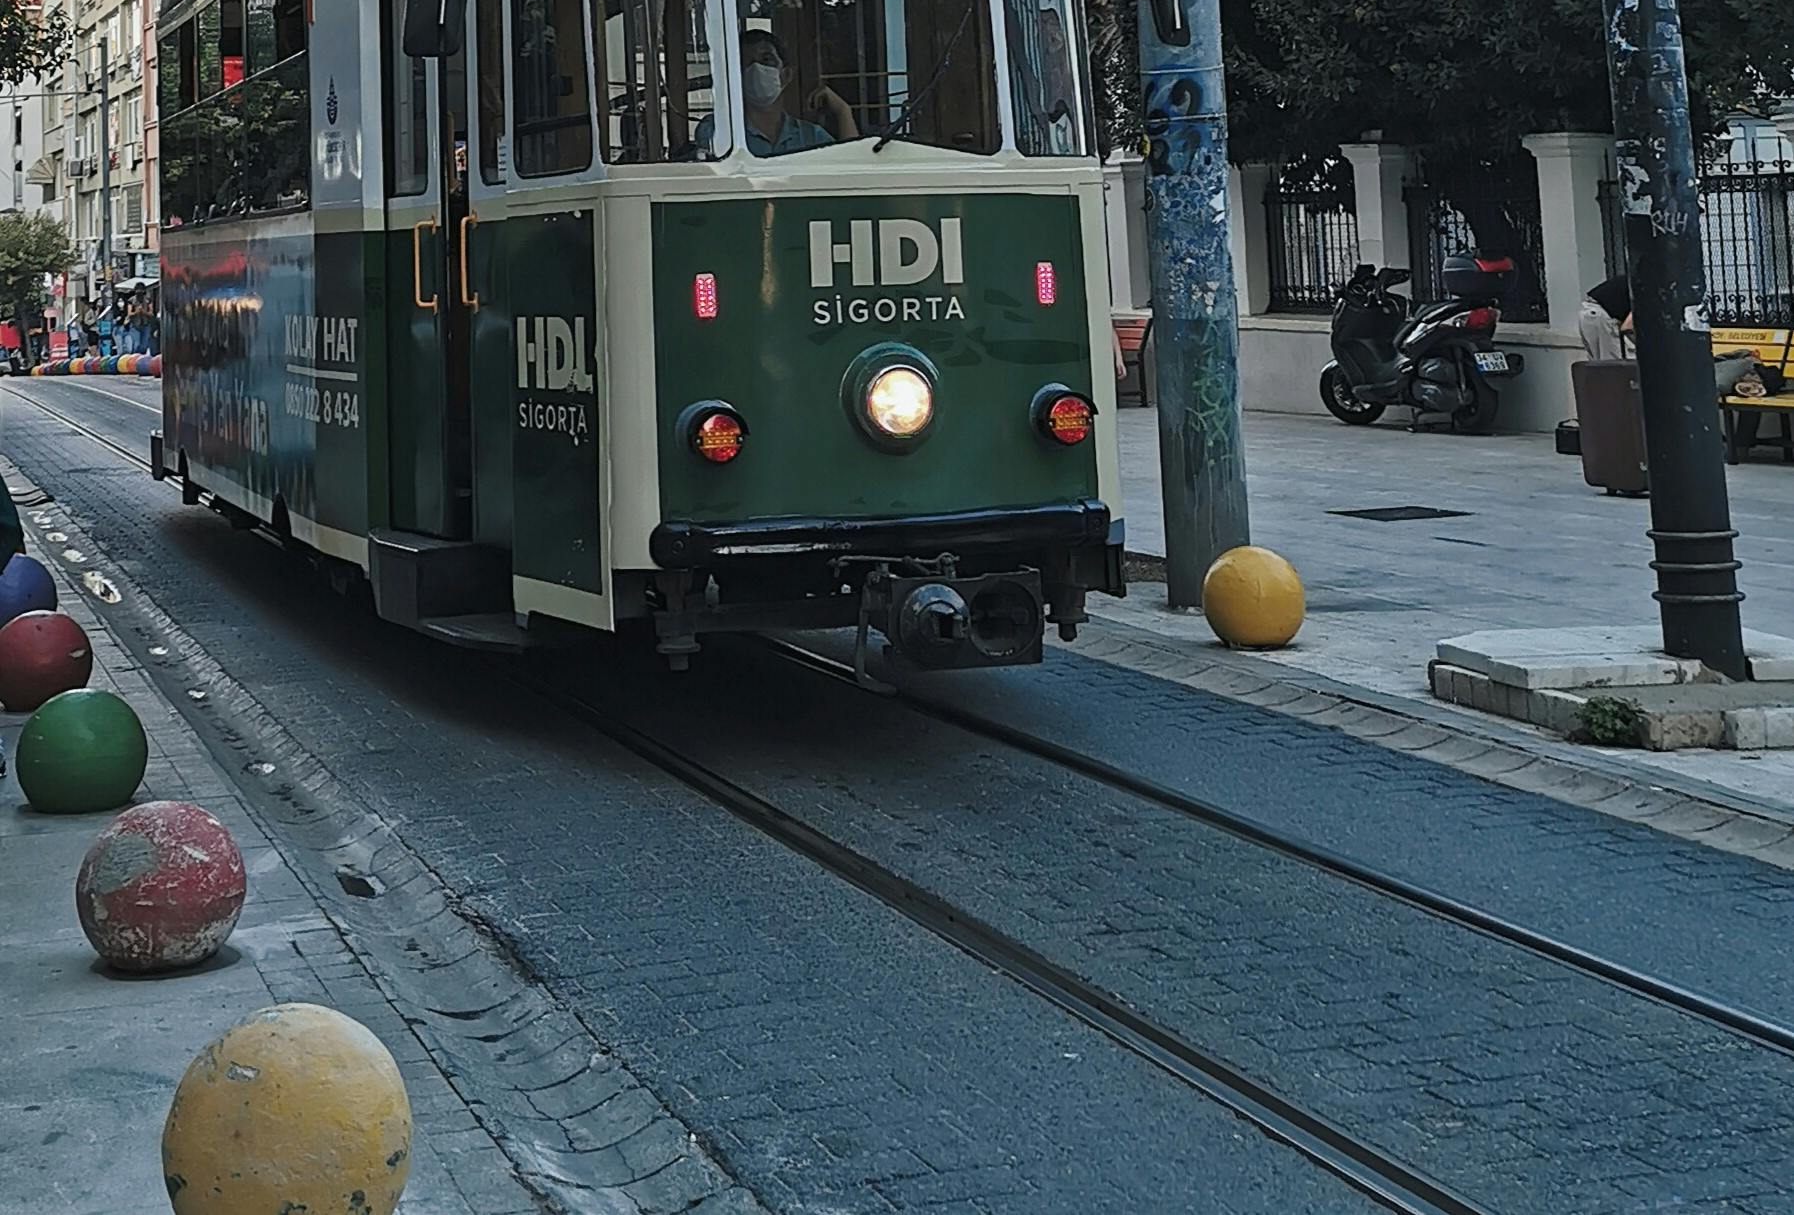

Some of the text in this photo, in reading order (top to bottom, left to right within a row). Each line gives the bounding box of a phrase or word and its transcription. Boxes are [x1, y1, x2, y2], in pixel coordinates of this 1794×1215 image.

[809, 218, 964, 287] HDI
[813, 295, 965, 324] SİGORTA
[284, 315, 318, 361] KOLAY
[323, 317, 358, 363] HAT
[209, 371, 233, 442] Yan
[234, 377, 268, 456] Yana
[323, 390, 332, 424] 8
[334, 391, 360, 429] 434
[519, 397, 588, 434] SİGORTA
